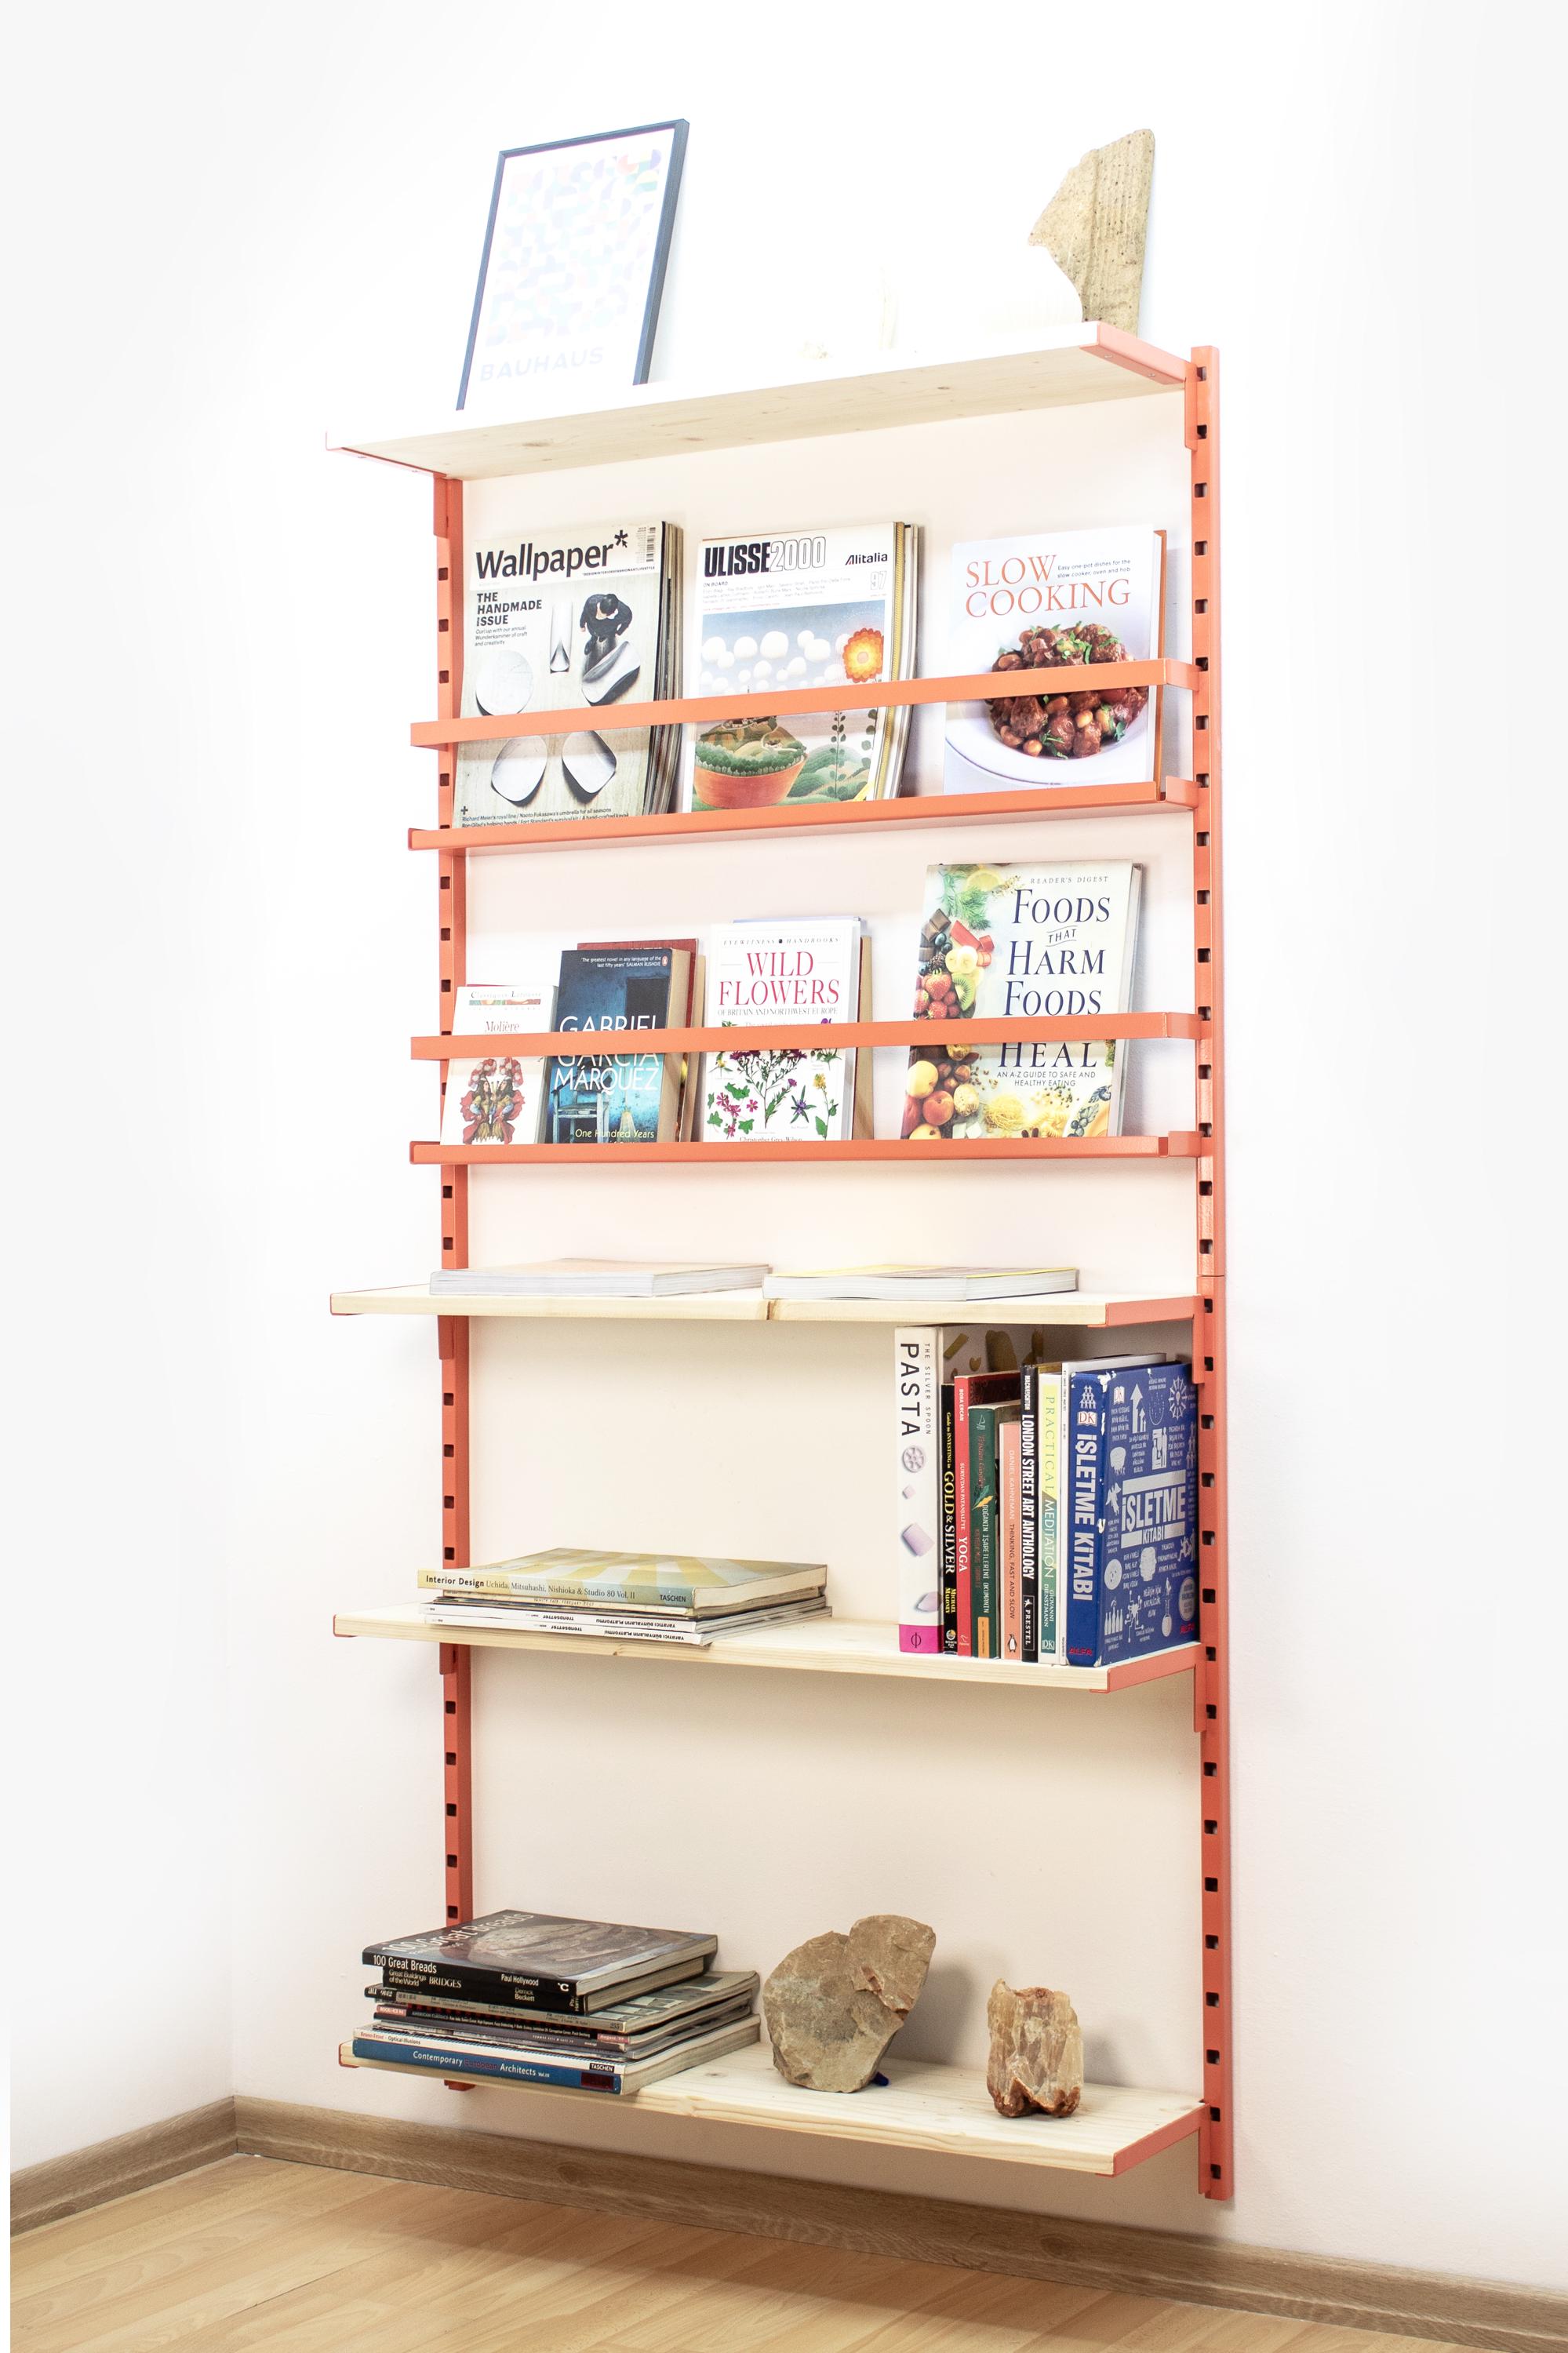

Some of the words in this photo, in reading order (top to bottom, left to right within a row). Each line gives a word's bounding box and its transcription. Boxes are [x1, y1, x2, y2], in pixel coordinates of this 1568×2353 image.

[478, 347, 604, 383] BAUHAUS
[845, 551, 888, 566] Alitalia
[966, 555, 1057, 588] SLOW
[477, 591, 498, 603] THE
[477, 599, 543, 615] HANDMADE
[966, 578, 1131, 618] COOKING
[476, 615, 509, 627] ISSUE
[1012, 889, 1110, 924] FOODS
[1048, 929, 1077, 944] THAT
[747, 951, 814, 977] WILD
[1007, 940, 1106, 976] HARM
[719, 979, 839, 1006] FLOWERS
[1002, 980, 1101, 1016] FOODS
[484, 1020, 520, 1033] Molière
[997, 1042, 1097, 1067] HEAL
[554, 1066, 659, 1095] MÁRQUEZ
[575, 1129, 592, 1138] One
[595, 1129, 631, 1138] Hundred
[633, 1129, 654, 1138] Years
[900, 1343, 921, 1436] PASTA
[1079, 1412, 1095, 1424] DK
[1022, 1414, 1035, 1456] LONDON
[1046, 1396, 1055, 1492] PRACTICAL
[1022, 1459, 1035, 1497] STREET
[1075, 1434, 1097, 1525] İŞLETME
[944, 1471, 955, 1515] GOLD
[1022, 1500, 1035, 1518] ART
[1121, 1484, 1187, 1533] İŞLETME
[944, 1524, 956, 1574] SILVER
[1044, 1499, 1055, 1578] MEDITATION
[1142, 1529, 1165, 1544] KİTABI
[959, 1537, 968, 1573] YOGA
[1022, 1522, 1035, 1580] ANTHOLOGY
[1072, 1532, 1095, 1601] KİTABI
[426, 1574, 456, 1584] Interior
[458, 1577, 485, 1588] Design
[548, 1584, 576, 1595] Nishioka
[584, 1588, 606, 1597] Studio
[617, 1590, 628, 1598] Vol.
[660, 1594, 686, 1602] TASCHEN
[1043, 1640, 1054, 1649] DK
[382, 1938, 427, 1952] 100
[373, 1955, 386, 1966] 100
[388, 1957, 409, 1970] Great
[410, 1959, 438, 1974] Breads
[388, 1969, 404, 1978] Great
[403, 1971, 427, 1982] Buildings
[403, 1978, 420, 1988] World
[429, 1976, 462, 1988] BRIDGES
[500, 1973, 513, 1983] Paul
[512, 1975, 540, 1987] Hollywood
[515, 1993, 535, 2002] Beckett
[387, 2035, 403, 2045] Optical
[403, 2037, 421, 2046] Illusions
[413, 2050, 463, 2067] Contemporary
[464, 2058, 498, 2071] European
[500, 2064, 537, 2077] Architects
[591, 2063, 613, 2072] TASCHEN
